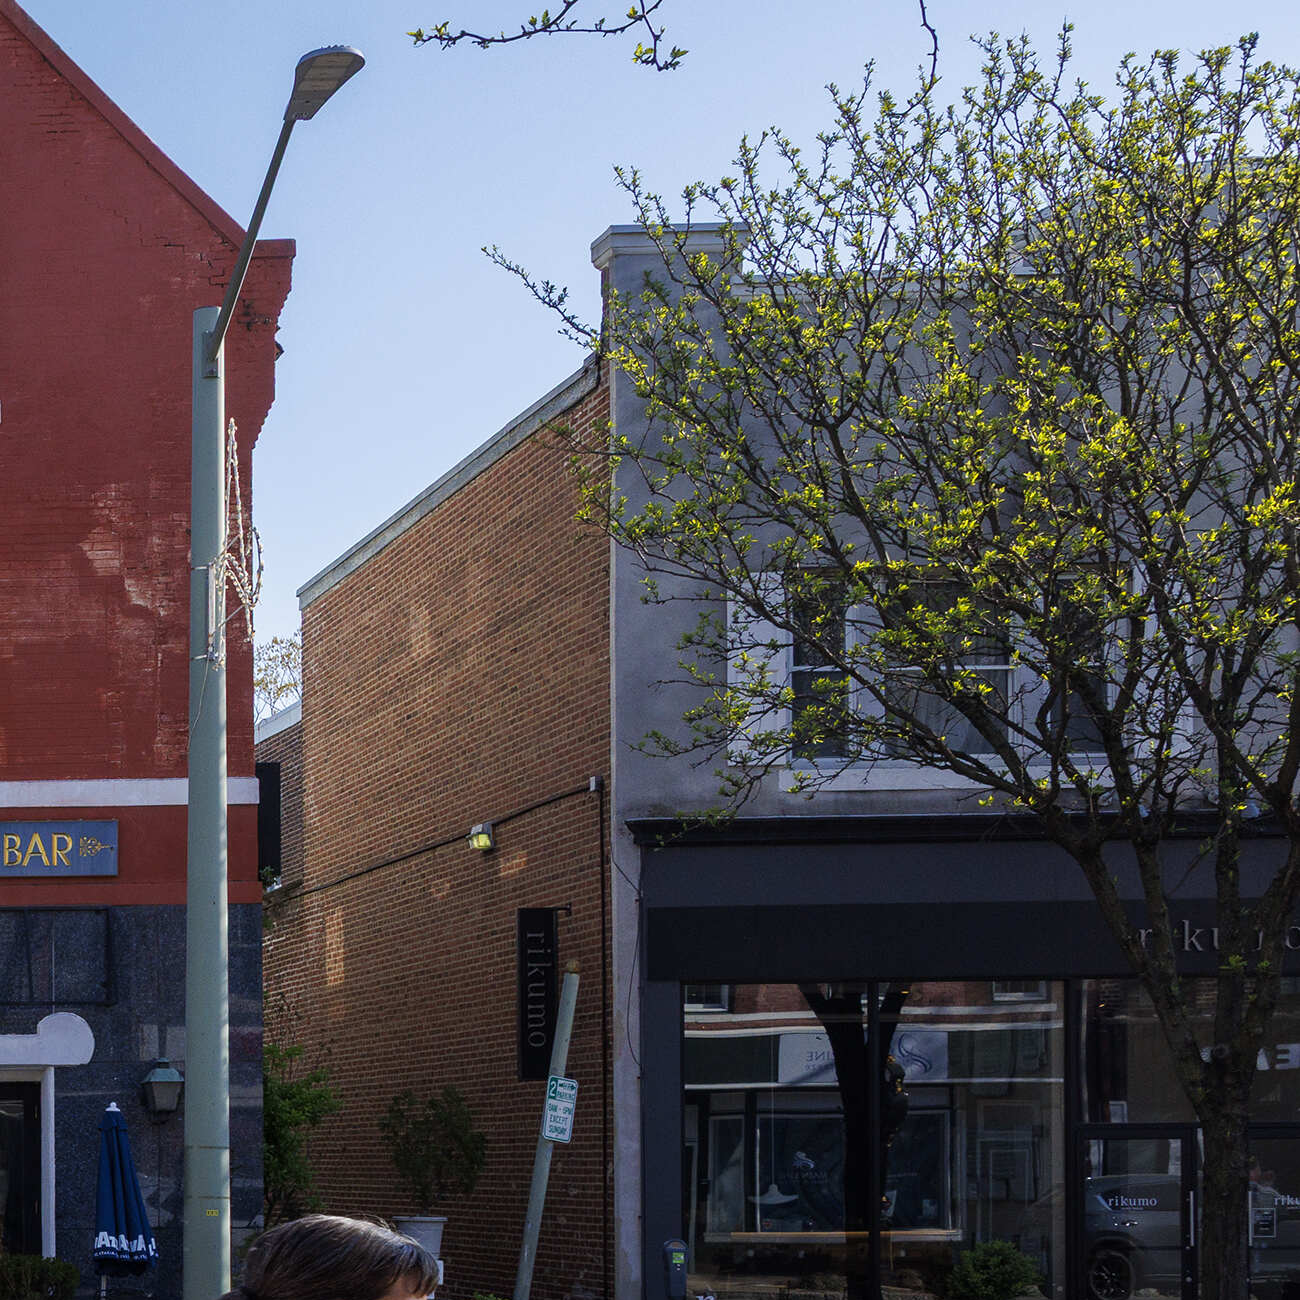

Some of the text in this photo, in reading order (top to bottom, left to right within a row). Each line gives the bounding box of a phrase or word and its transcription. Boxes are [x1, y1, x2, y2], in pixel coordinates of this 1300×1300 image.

[4, 832, 72, 866] BAR
[527, 932, 553, 1048] rikumo
[1108, 1196, 1158, 1207] rikumo
